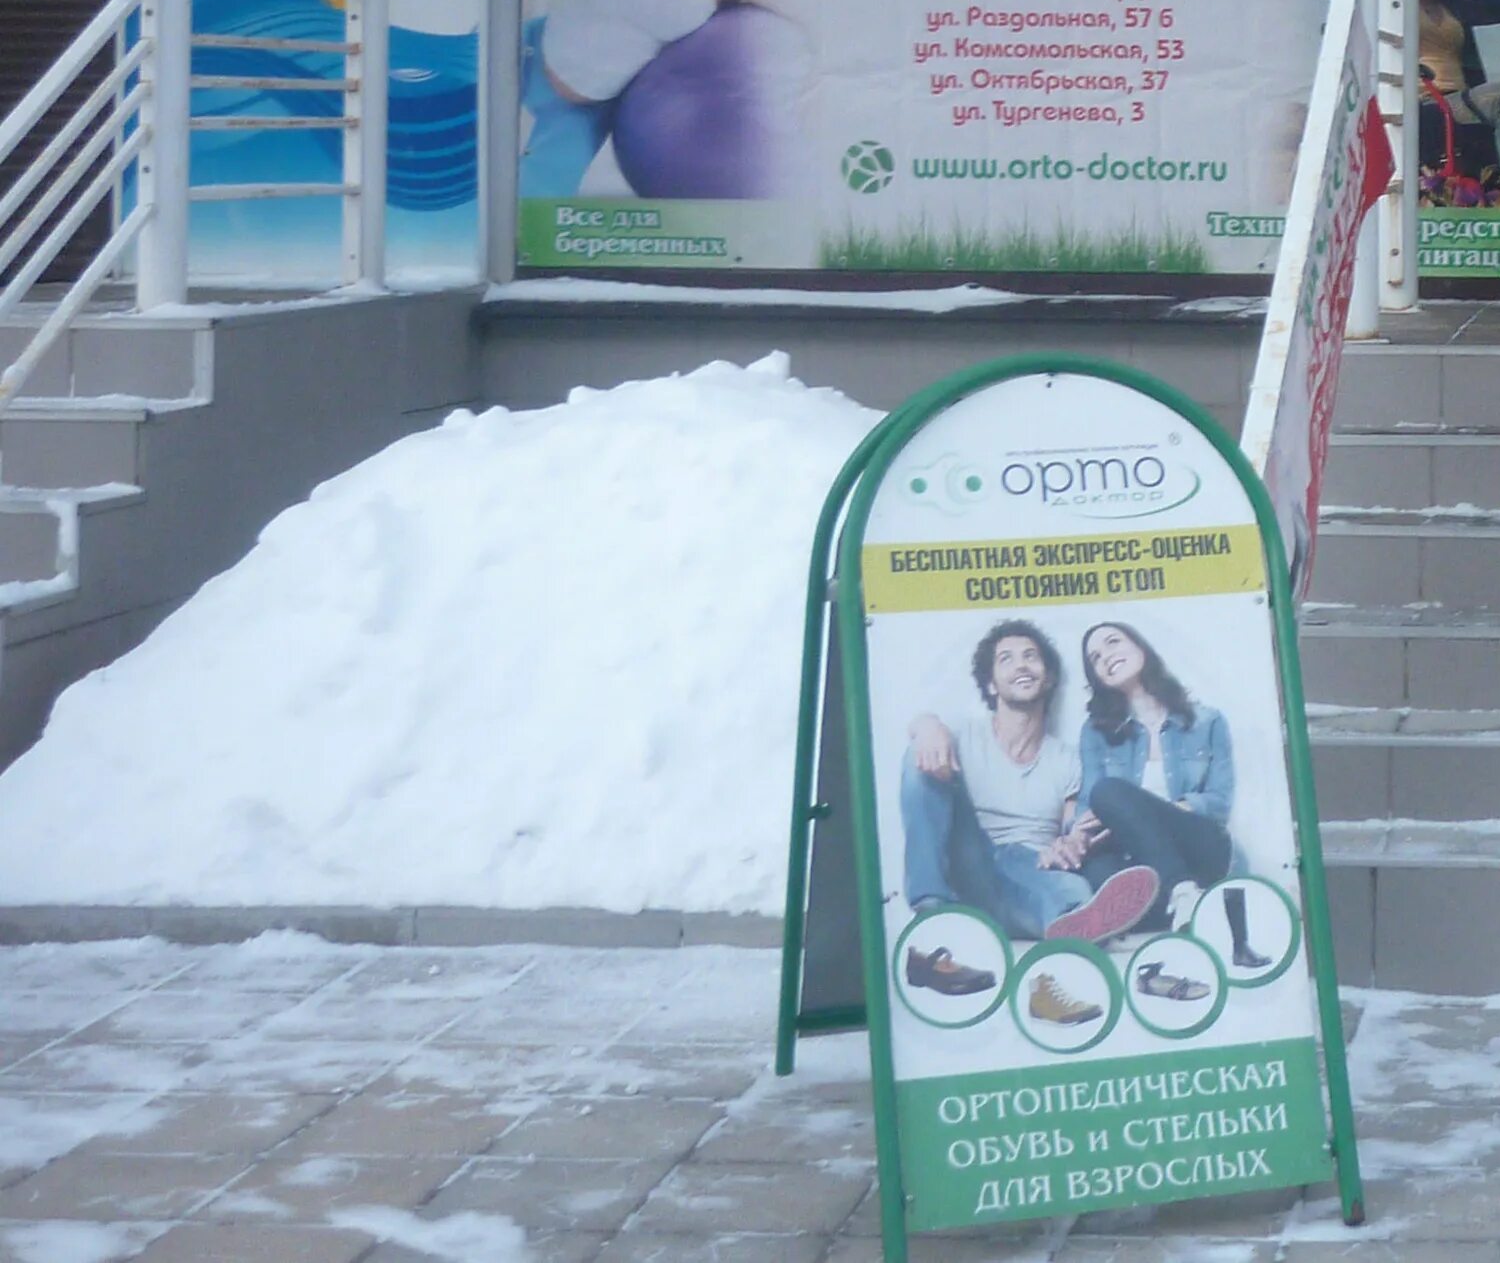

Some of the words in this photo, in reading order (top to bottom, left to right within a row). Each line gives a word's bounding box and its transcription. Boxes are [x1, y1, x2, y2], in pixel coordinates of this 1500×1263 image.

[926, 11, 960, 31] ул.
[966, 7, 1116, 32] Раздольная,
[1124, 7, 1152, 28] 57
[913, 42, 948, 63] ул.
[954, 38, 1148, 63] Комсомольская,
[1156, 39, 1185, 59] 53
[930, 74, 964, 94] ул.
[970, 69, 1134, 94] Октябрьская,
[1140, 70, 1169, 90] 37
[952, 105, 986, 125] ул.
[992, 100, 1124, 126] Тургенева,
[1130, 102, 1145, 121] 3
[912, 152, 1228, 182] www.orto-doctor.ru
[556, 206, 604, 226] Все
[612, 211, 660, 229] для
[555, 231, 727, 257] беременных
[890, 543, 1027, 573] БЕСПЛАТНАЯ
[1033, 533, 1231, 567] ЭКСПРЕСС-ОЦЕНКА
[965, 572, 1099, 602] СОСТОЯНИЯ
[1106, 566, 1166, 593] СТОП
[938, 1060, 1288, 1125] ОРТОПЕДИЧЕСКАЯ
[947, 1133, 1075, 1169] ОБУВЬ
[1089, 1133, 1109, 1153] и
[1123, 1103, 1289, 1148] СТЕЛЬКИ
[974, 1176, 1053, 1216] ДЛЯ
[1067, 1148, 1272, 1200] ВЗРОСЛЫХ
